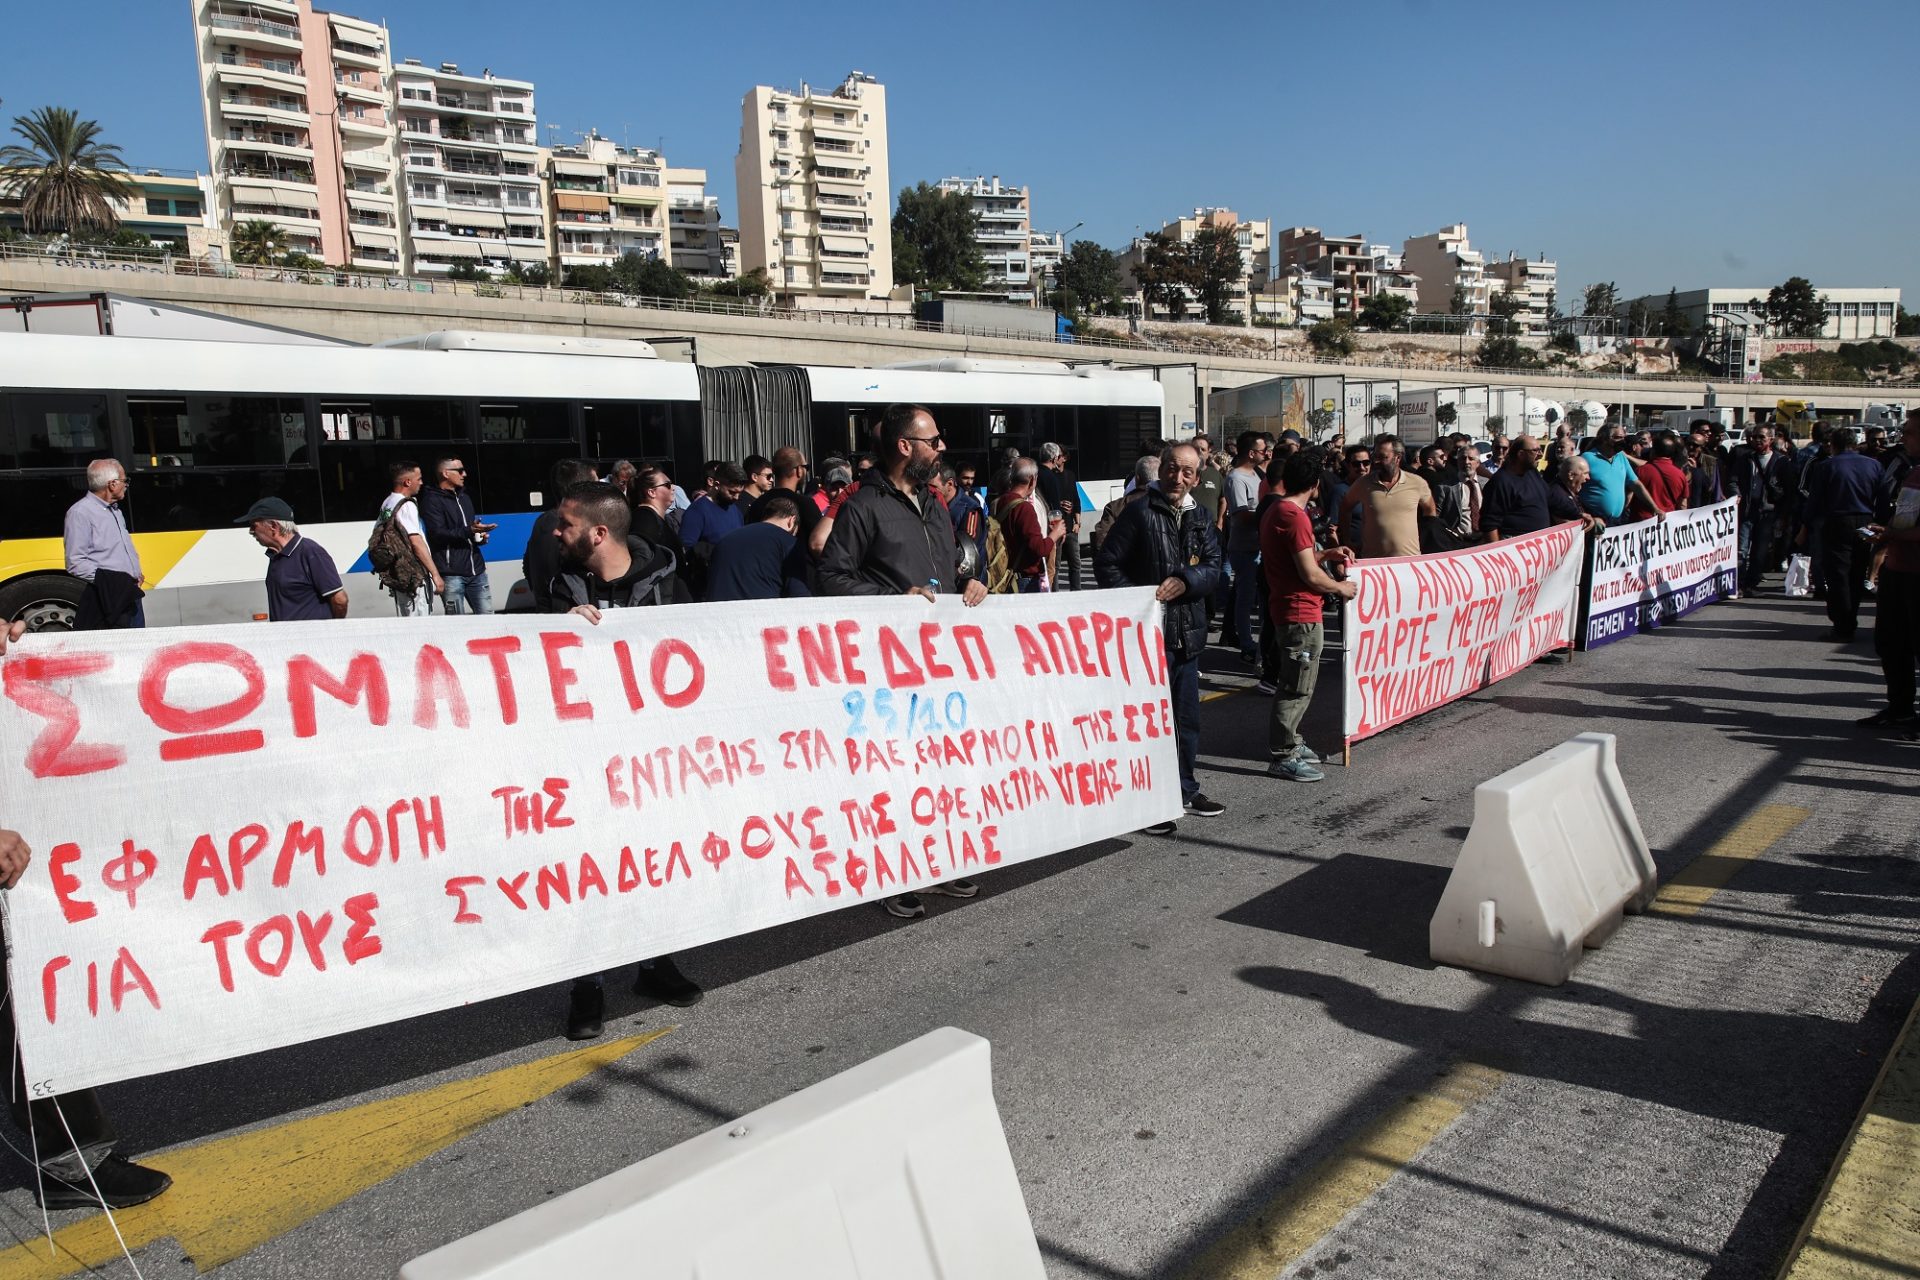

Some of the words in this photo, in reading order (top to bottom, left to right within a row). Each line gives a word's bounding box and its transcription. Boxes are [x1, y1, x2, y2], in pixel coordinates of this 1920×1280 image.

[1638, 521, 1672, 562] ΧΕΡΙΑ
[1673, 511, 1697, 551] από
[1696, 518, 1715, 547] τις
[1712, 505, 1736, 539] ΣΣΕ
[1358, 565, 1402, 625] ΟΧΙ
[1410, 556, 1474, 612] ΑΛΛΟ
[1471, 550, 1522, 597] ΑΙΜΑ
[1592, 580, 1608, 603] και
[1609, 579, 1622, 599] τα
[1665, 562, 1684, 581] των
[1355, 612, 1438, 676] ΠΑΡΤΕ
[1447, 593, 1504, 651] ΜΕΤΡΑ
[1589, 610, 1625, 642] ΠΕΜΕΝ
[1, 630, 706, 779] ΣΩΜΑΤΕΙΟ
[761, 618, 997, 693] ΕΝΕΔΕΠ
[842, 688, 968, 739] 25/10
[1357, 655, 1455, 734] ΣΥΝΔΙΚΑΤΟ
[48, 795, 446, 924] ΕΦΑΡΜΟΓΗ
[492, 777, 576, 840] ΤΗΣ
[605, 735, 767, 812] ΕΝΤΑΞΗΣ
[778, 727, 838, 773] ΣΤΑ
[1072, 710, 1119, 751] ΤΗΣ
[1123, 698, 1172, 743] ΣΣΕ
[42, 946, 162, 1025] ΓΙΑ
[200, 892, 383, 993] ΤΟΥΣ
[444, 806, 828, 924] ΣΥΝΑΔΕΛΦΟΥΣ
[839, 791, 897, 842] ΤΗΣ
[1049, 758, 1123, 807] ΥΓΕΙΑΣ
[1129, 755, 1153, 792] ΚΑΙ
[784, 825, 1001, 899] ΑΣΦΑΛΕΙΑΣ
